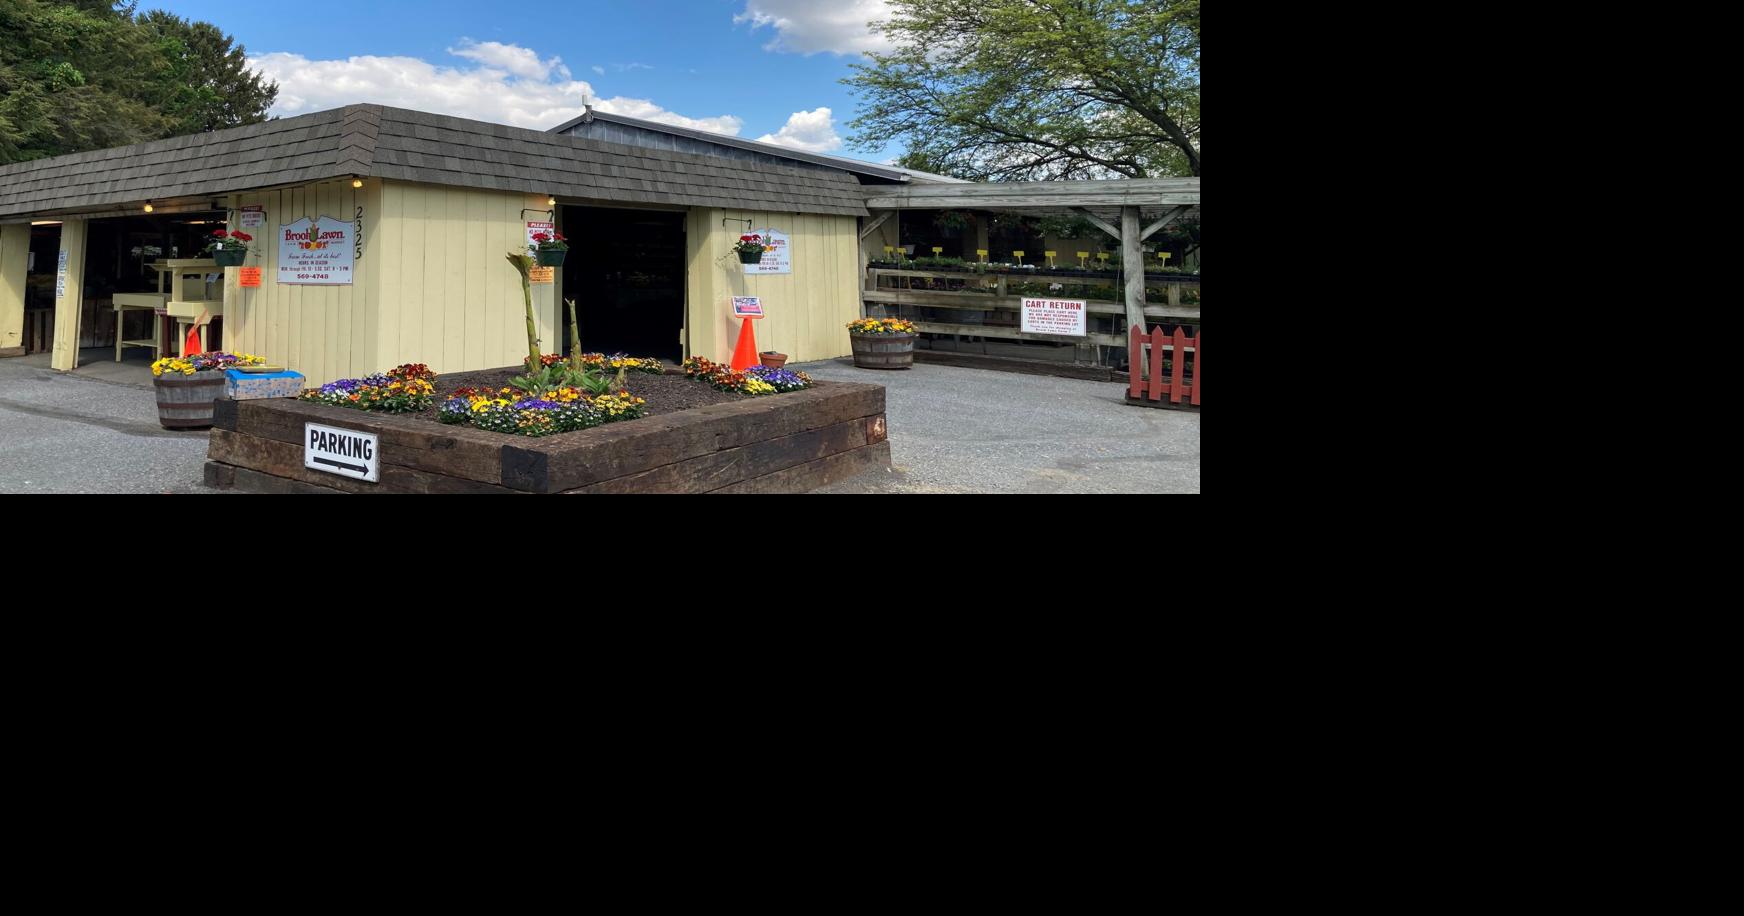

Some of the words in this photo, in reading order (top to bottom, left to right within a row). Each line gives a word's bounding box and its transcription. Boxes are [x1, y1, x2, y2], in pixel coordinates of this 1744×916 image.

[355, 206, 363, 260] 2325
[1025, 300, 1046, 308] CART
[1049, 301, 1081, 310] RETURN
[310, 429, 372, 460] PARKING
